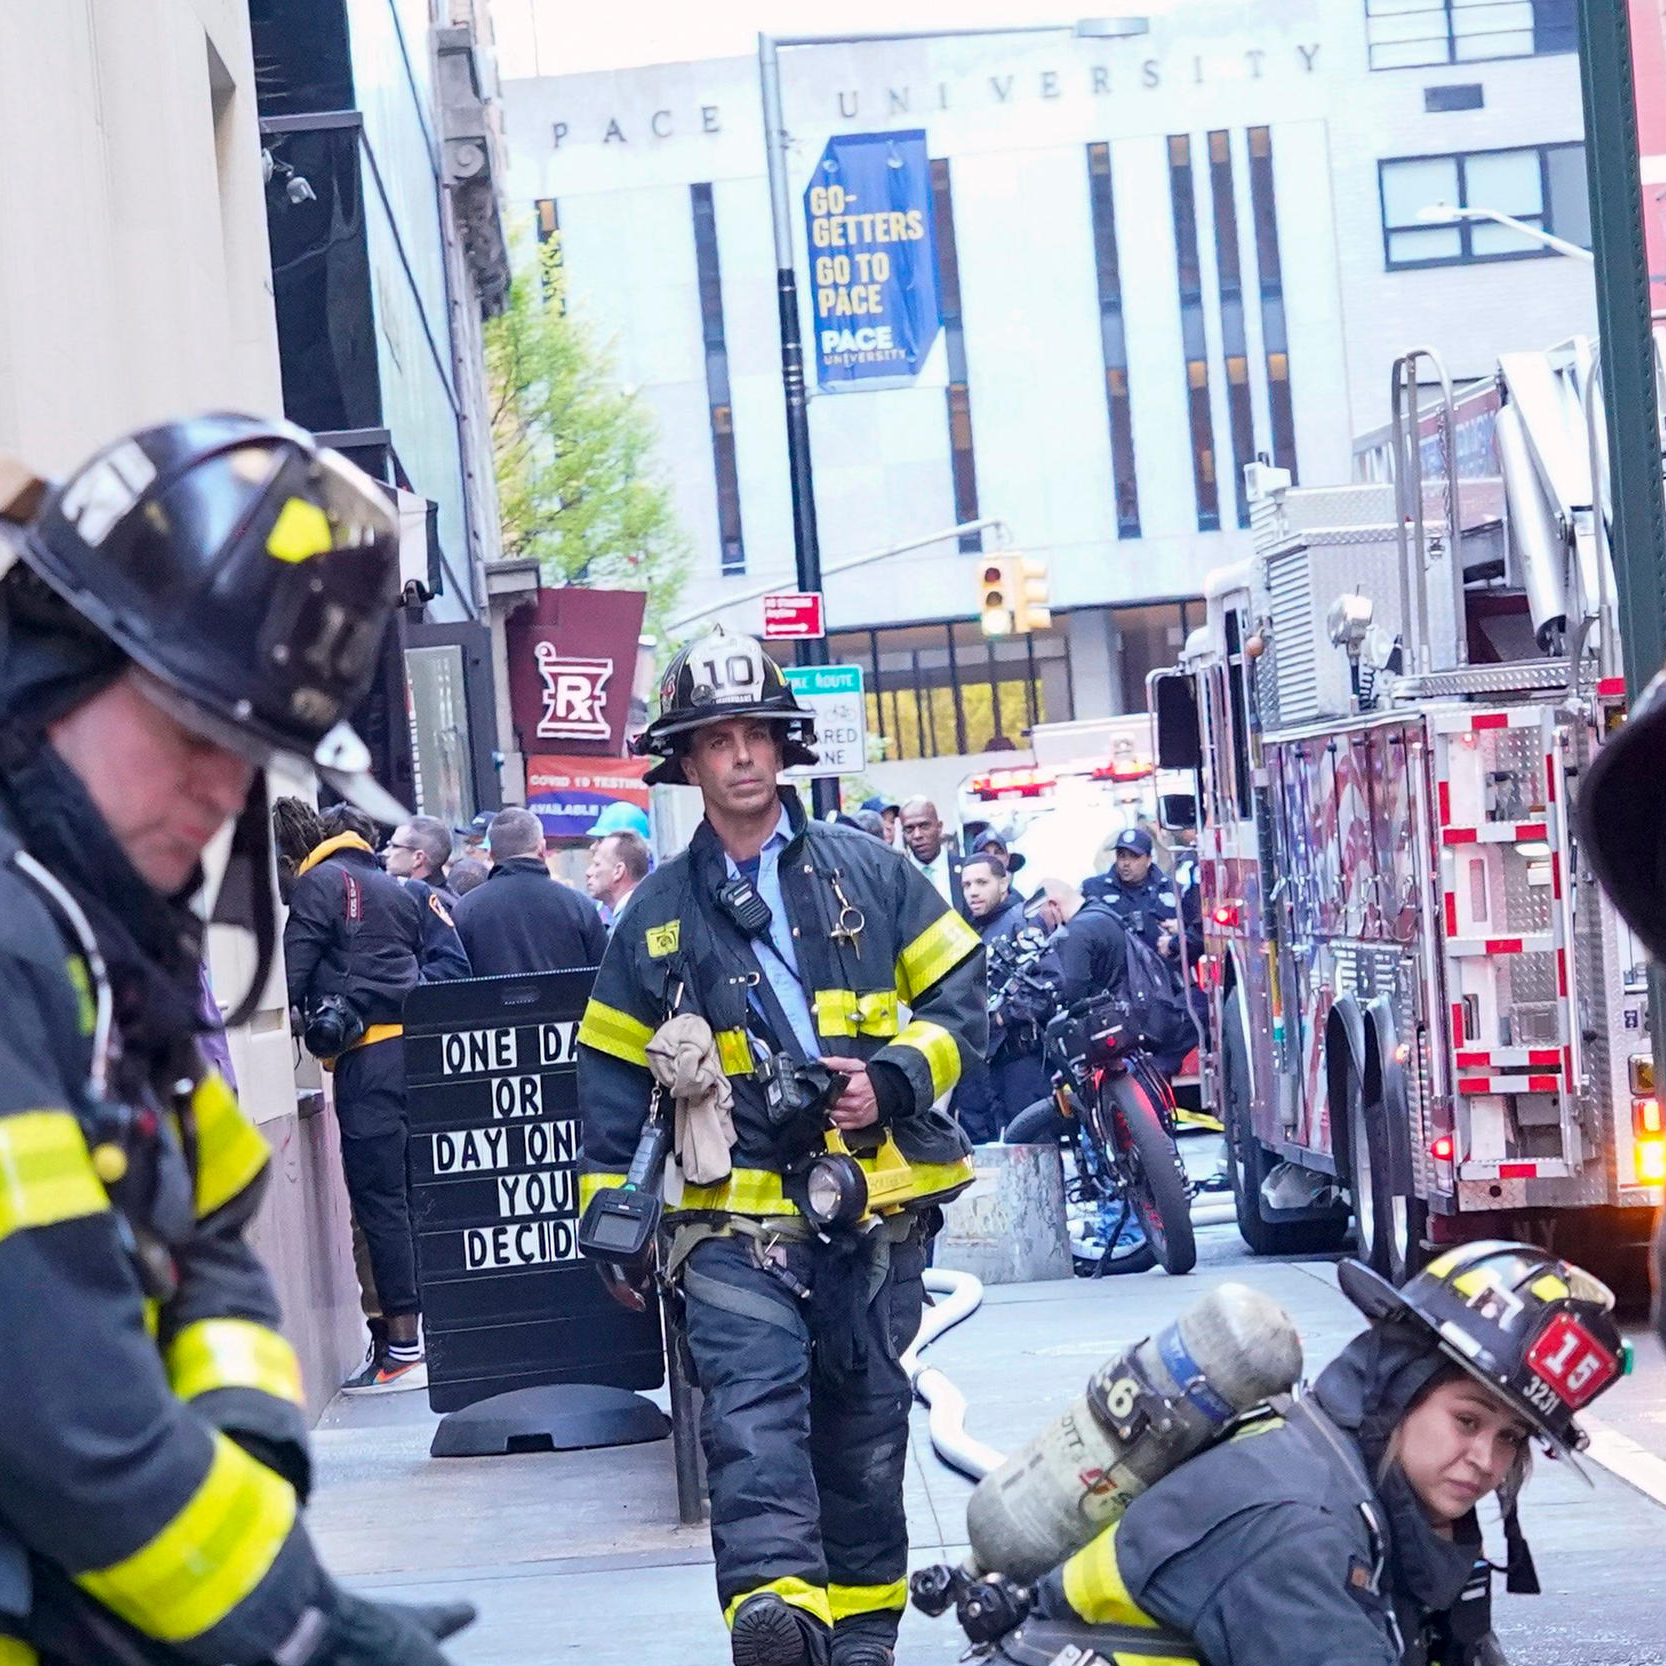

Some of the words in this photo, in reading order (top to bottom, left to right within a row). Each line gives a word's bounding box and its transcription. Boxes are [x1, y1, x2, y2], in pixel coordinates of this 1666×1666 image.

[553, 104, 721, 149] PACE
[838, 43, 1321, 120] UNIVERSITY
[810, 184, 858, 217] GO-
[812, 209, 924, 249] GETTERS
[816, 254, 851, 287] GO
[854, 251, 891, 284] TO
[818, 284, 884, 318] PACE
[821, 325, 894, 354] PACE
[823, 349, 907, 366] UNIVERSITY
[703, 655, 754, 690] 10
[556, 674, 593, 721] Rx
[529, 774, 570, 788] COVID
[528, 803, 600, 817] AVAILABLE
[445, 1028, 514, 1074] ONE
[544, 1024, 580, 1062] DA
[495, 1075, 540, 1118] OR
[435, 1128, 504, 1172] DAY
[500, 1169, 570, 1217] YOU
[467, 1220, 578, 1268] DECID
[1541, 1330, 1603, 1394] 15
[1522, 1376, 1561, 1417] 3231
